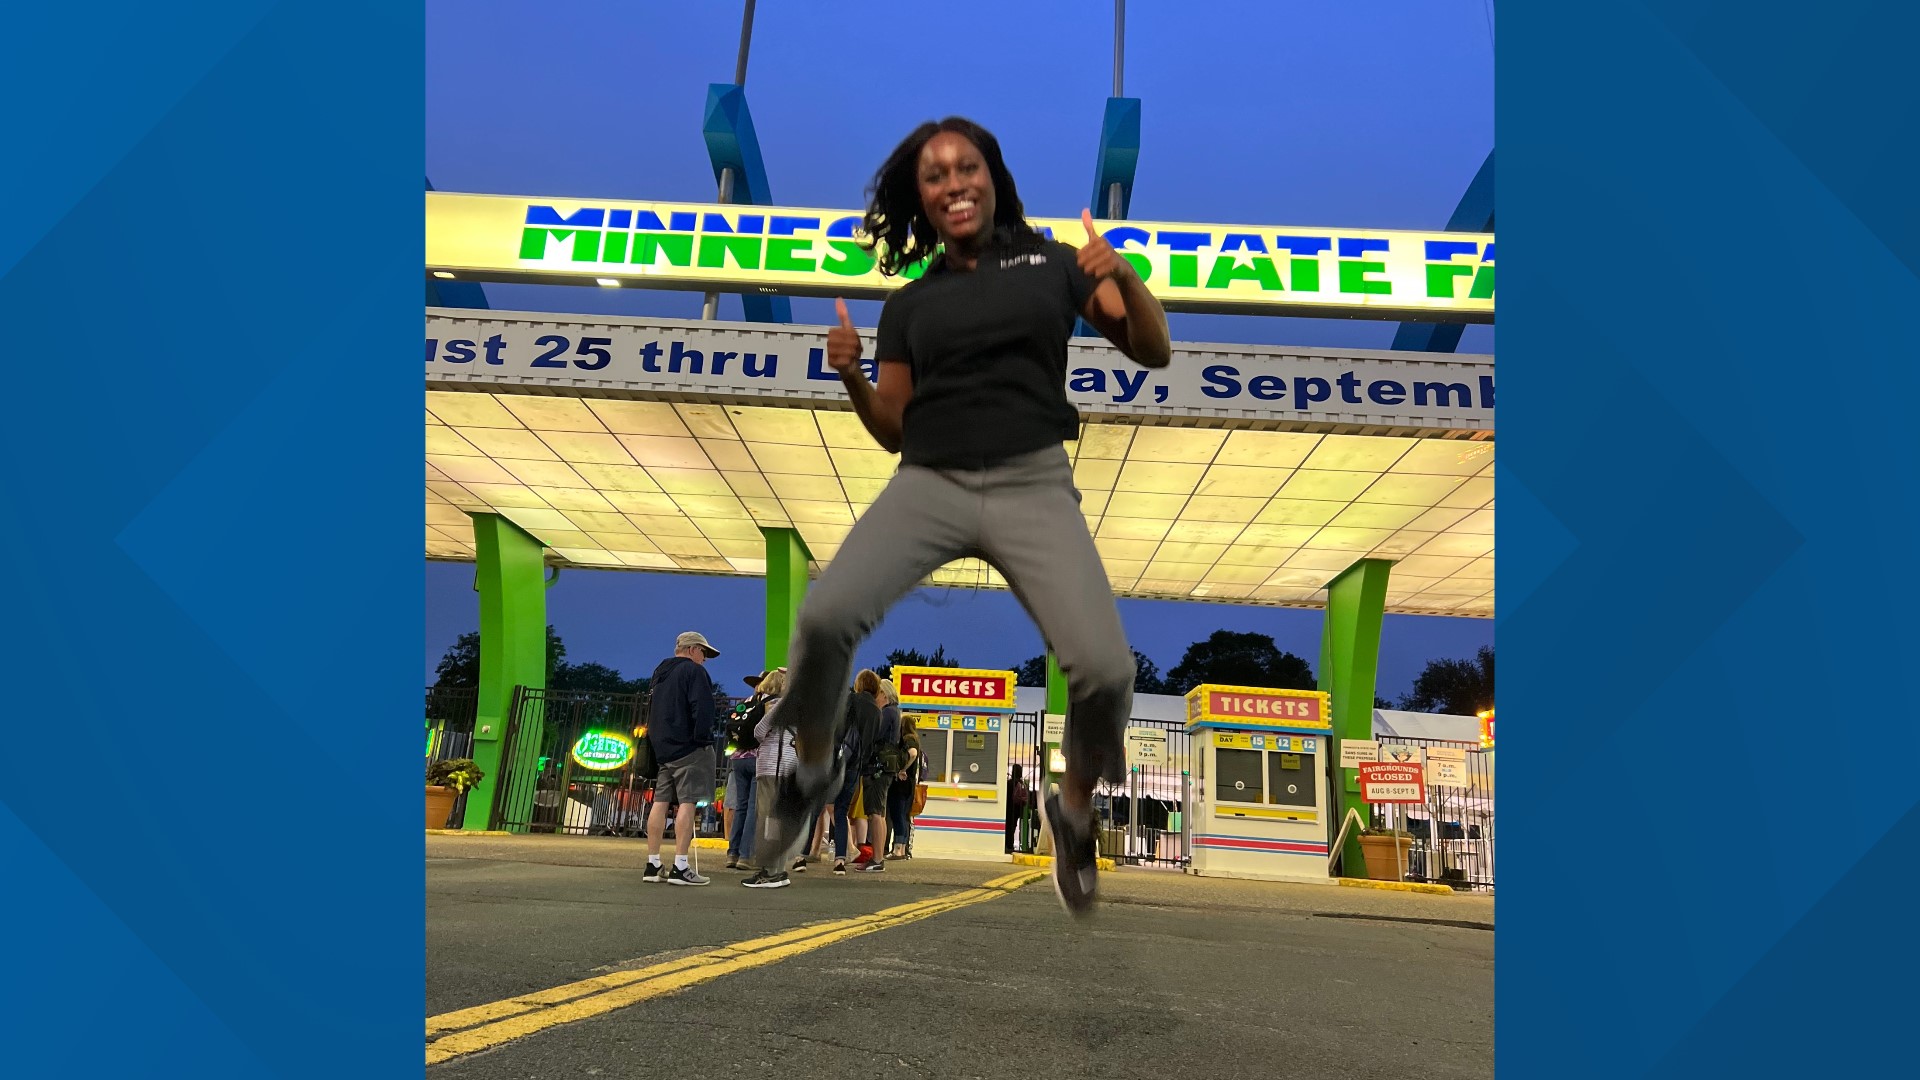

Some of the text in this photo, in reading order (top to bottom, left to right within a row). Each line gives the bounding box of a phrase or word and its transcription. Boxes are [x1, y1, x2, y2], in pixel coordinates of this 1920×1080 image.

[519, 205, 1053, 280] MINNES
[530, 334, 612, 371] 25
[639, 340, 778, 379] thru
[1068, 367, 1169, 404] ay,
[911, 678, 995, 696] TICKETS
[1220, 697, 1310, 717] TICKETS
[939, 717, 950, 725] 15
[963, 718, 975, 727] 12
[988, 719, 1000, 728] 12
[1252, 736, 1264, 746] 15
[1277, 738, 1289, 747] 12
[1303, 740, 1315, 749] 12
[1362, 765, 1419, 774] FAIRGROUNDS
[1370, 773, 1413, 781] CLOSED
